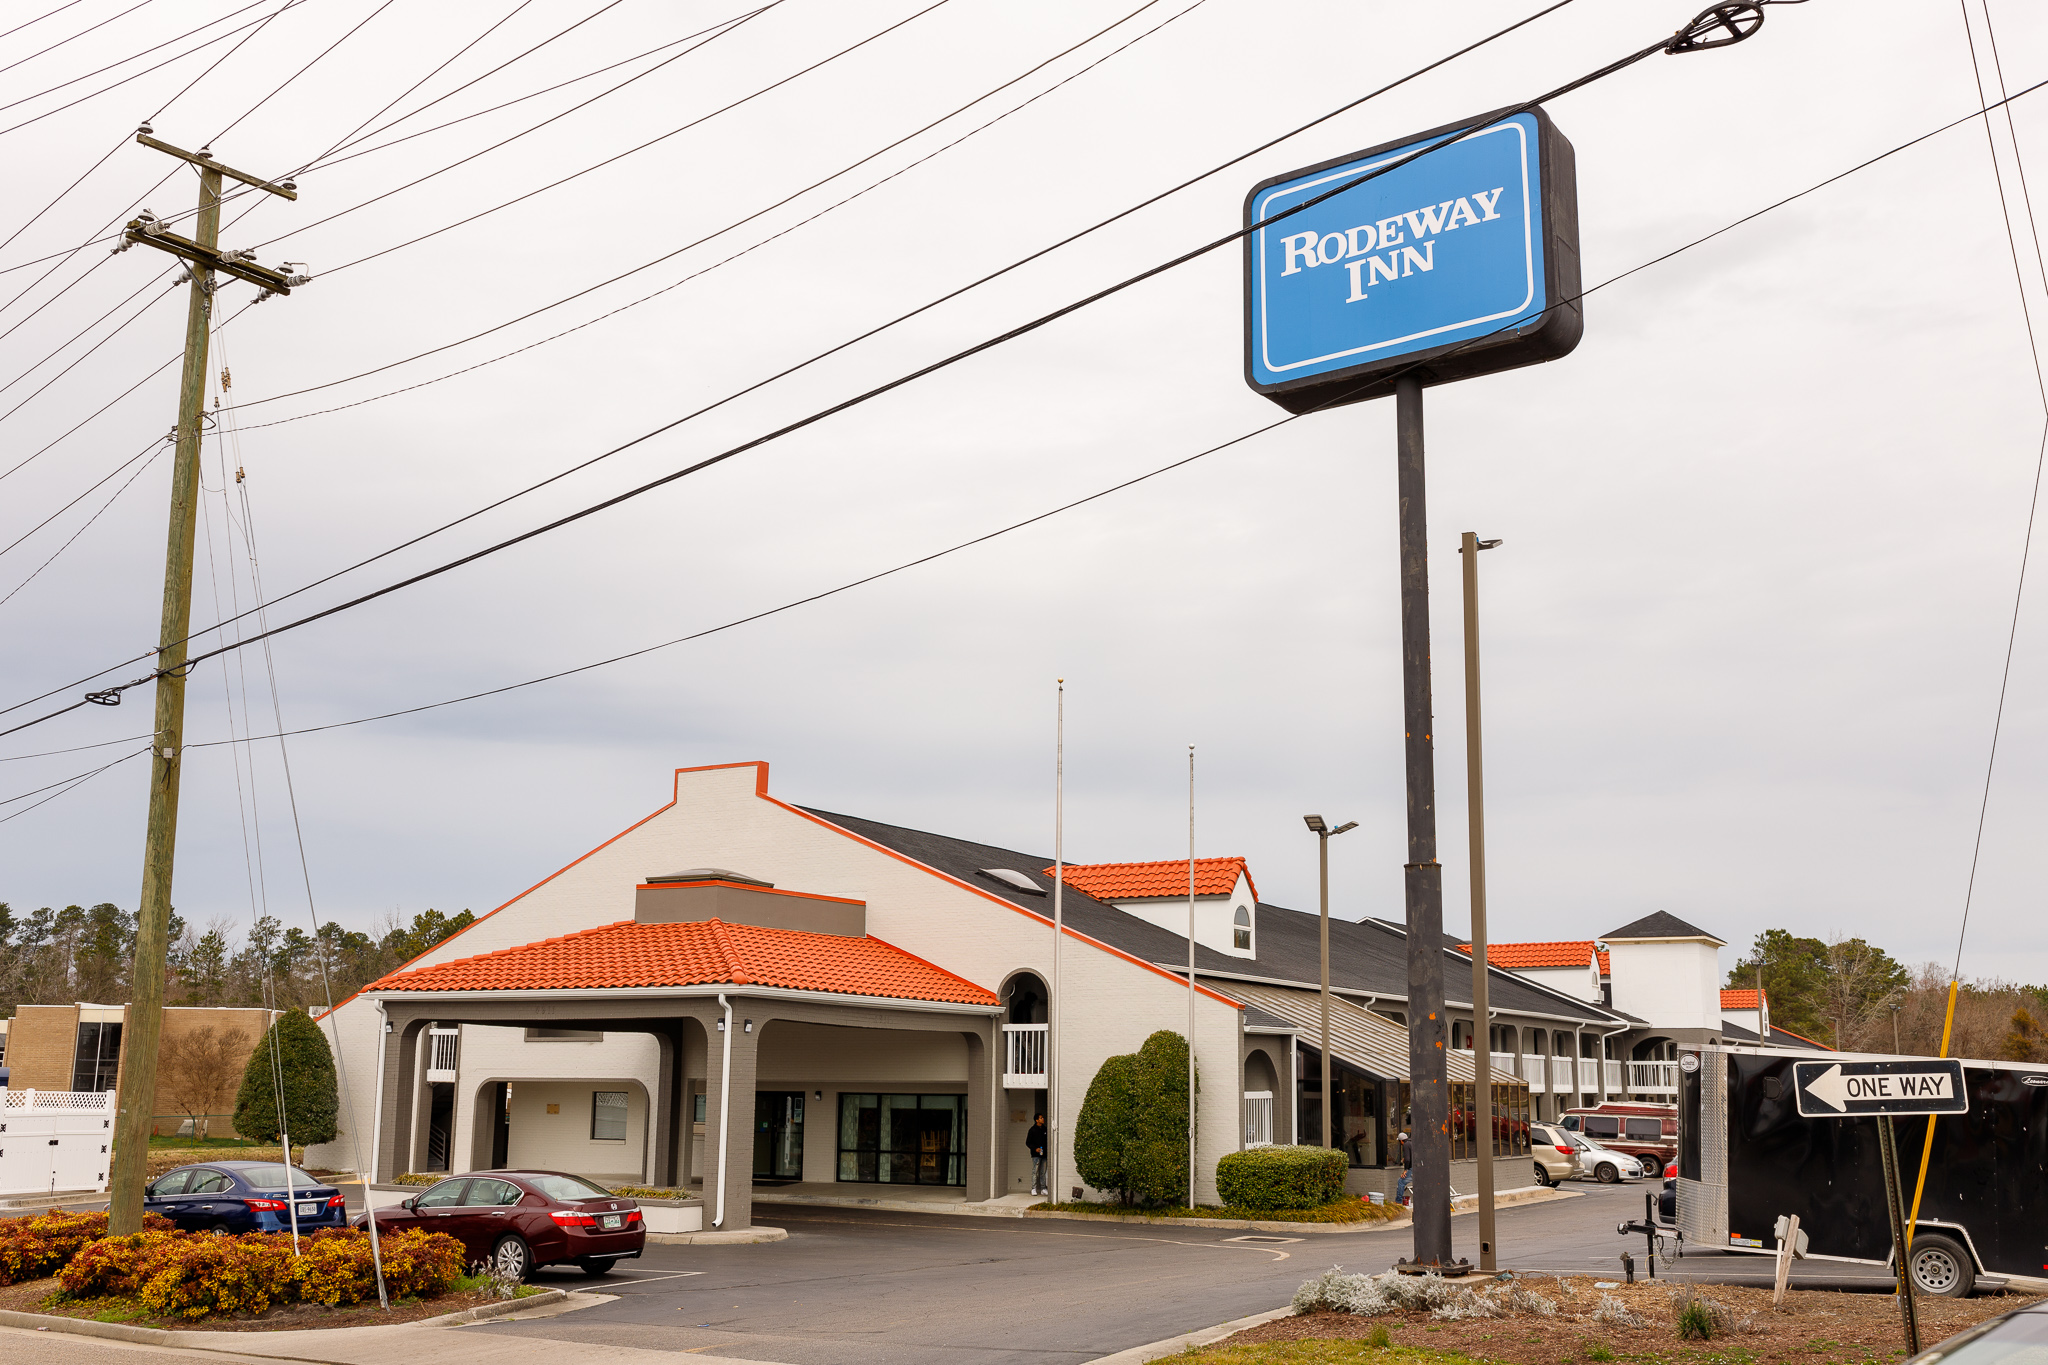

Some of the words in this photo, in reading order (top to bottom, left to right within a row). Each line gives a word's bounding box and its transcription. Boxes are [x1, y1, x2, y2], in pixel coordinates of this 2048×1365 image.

[1280, 187, 1504, 277] RODEWAY
[1344, 240, 1436, 304] INN
[1846, 1077, 1892, 1098] ONE
[1899, 1076, 1945, 1097] WAY
